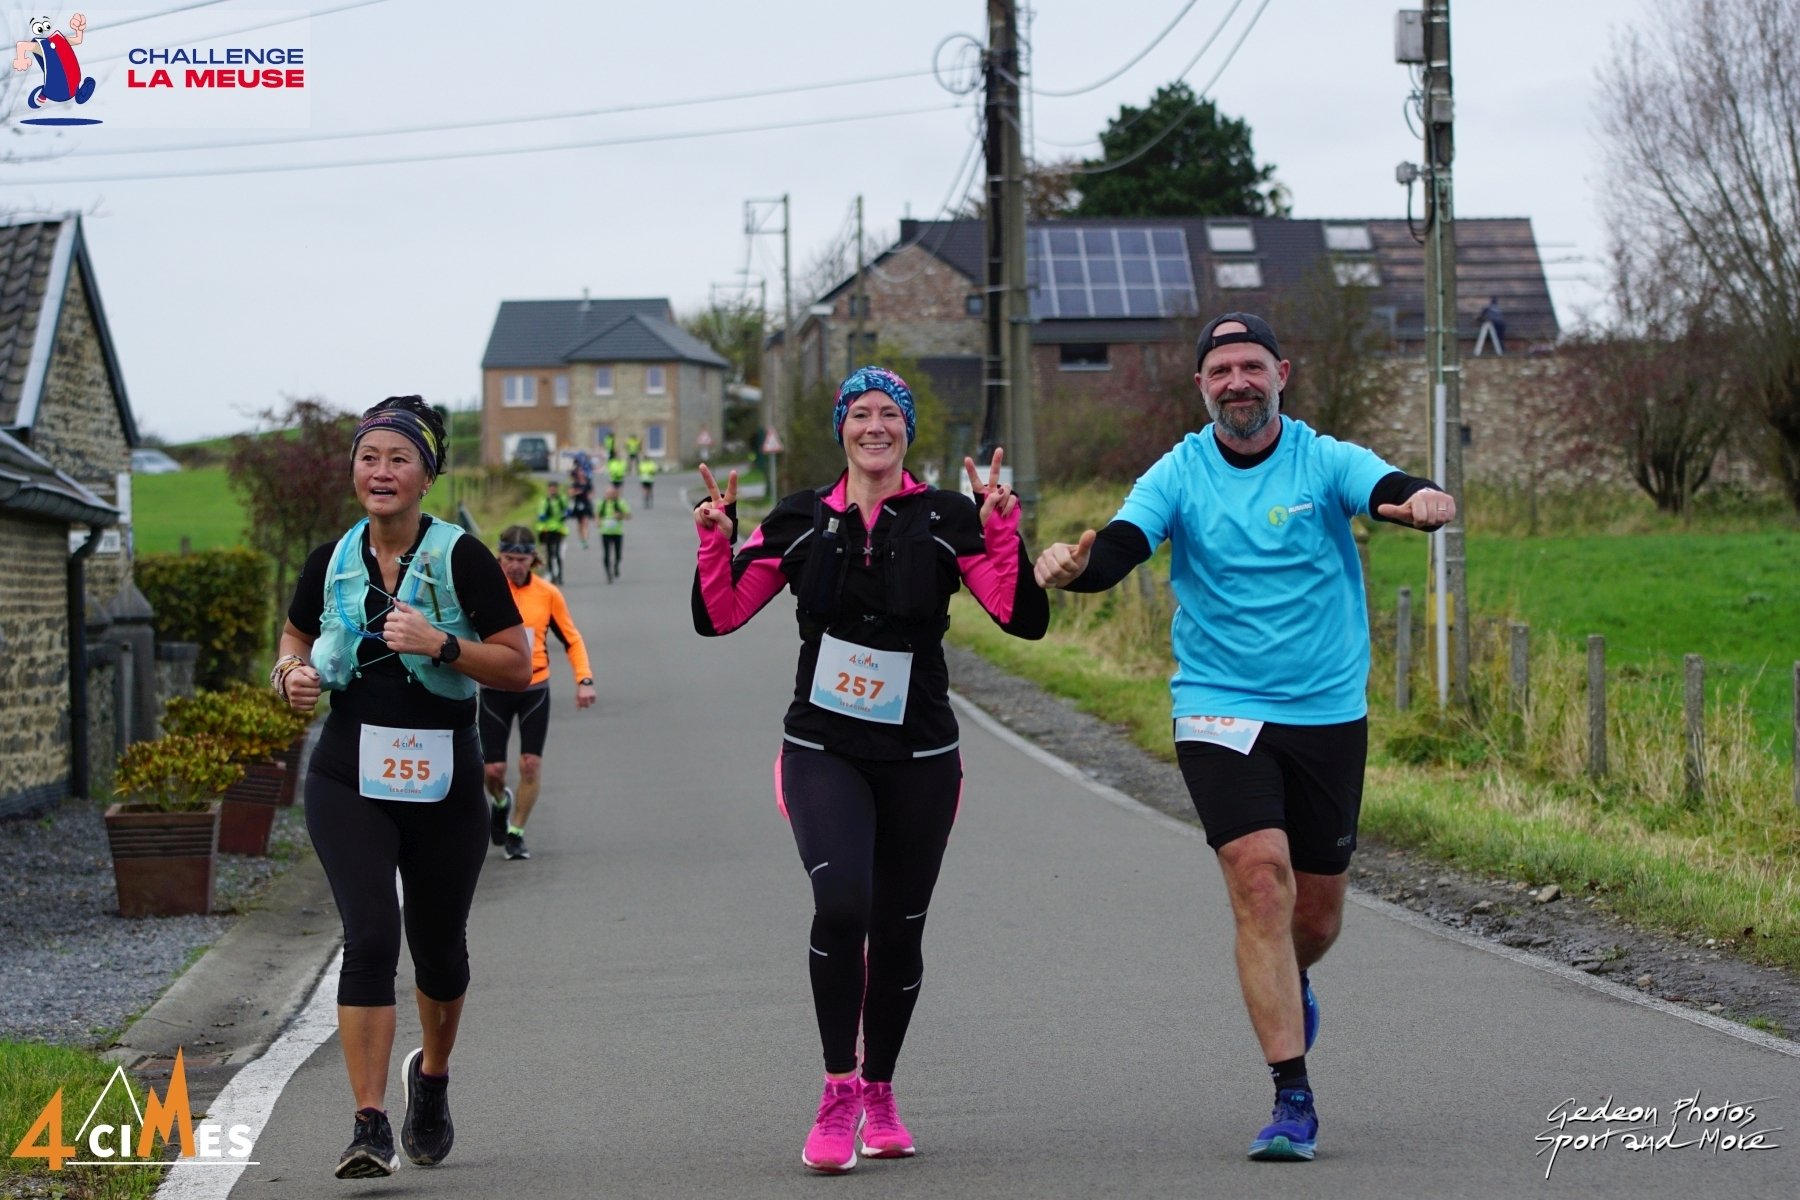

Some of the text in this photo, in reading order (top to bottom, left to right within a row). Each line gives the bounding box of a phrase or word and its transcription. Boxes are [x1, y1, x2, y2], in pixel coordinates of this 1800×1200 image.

[848, 653, 857, 665] 4
[835, 672, 885, 699] 257
[392, 734, 423, 748] 4 CIMES
[382, 758, 430, 780] 255
